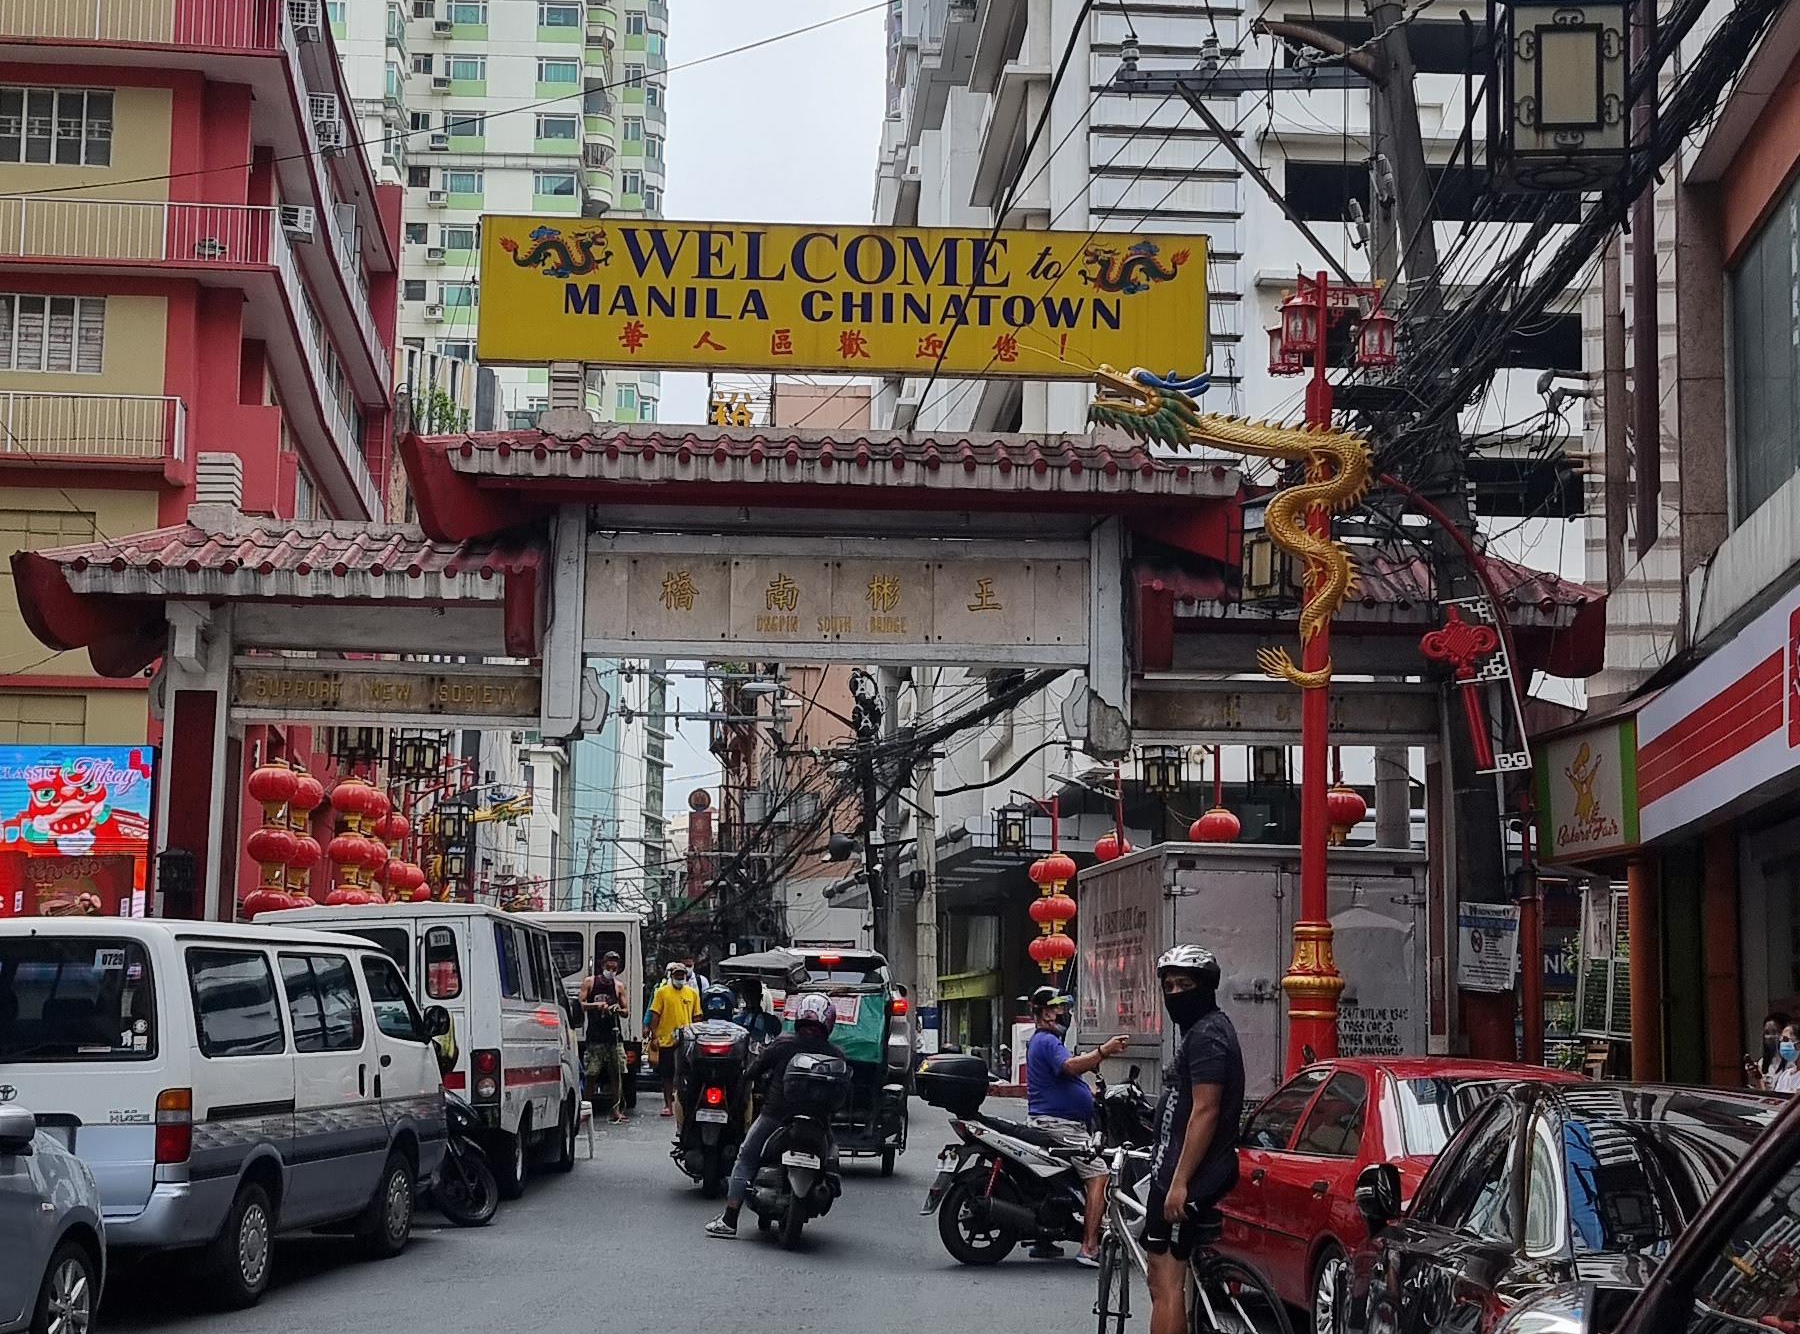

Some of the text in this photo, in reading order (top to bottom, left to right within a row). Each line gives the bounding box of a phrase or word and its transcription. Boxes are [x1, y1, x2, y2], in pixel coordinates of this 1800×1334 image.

[617, 227, 1063, 288] WELCOME to
[564, 282, 1121, 330] MANILA CHINATOWN
[816, 614, 851, 633] SOUTH
[255, 678, 519, 706] SUPPORT NEW SOCIETY
[0, 766, 58, 780] LASSIC
